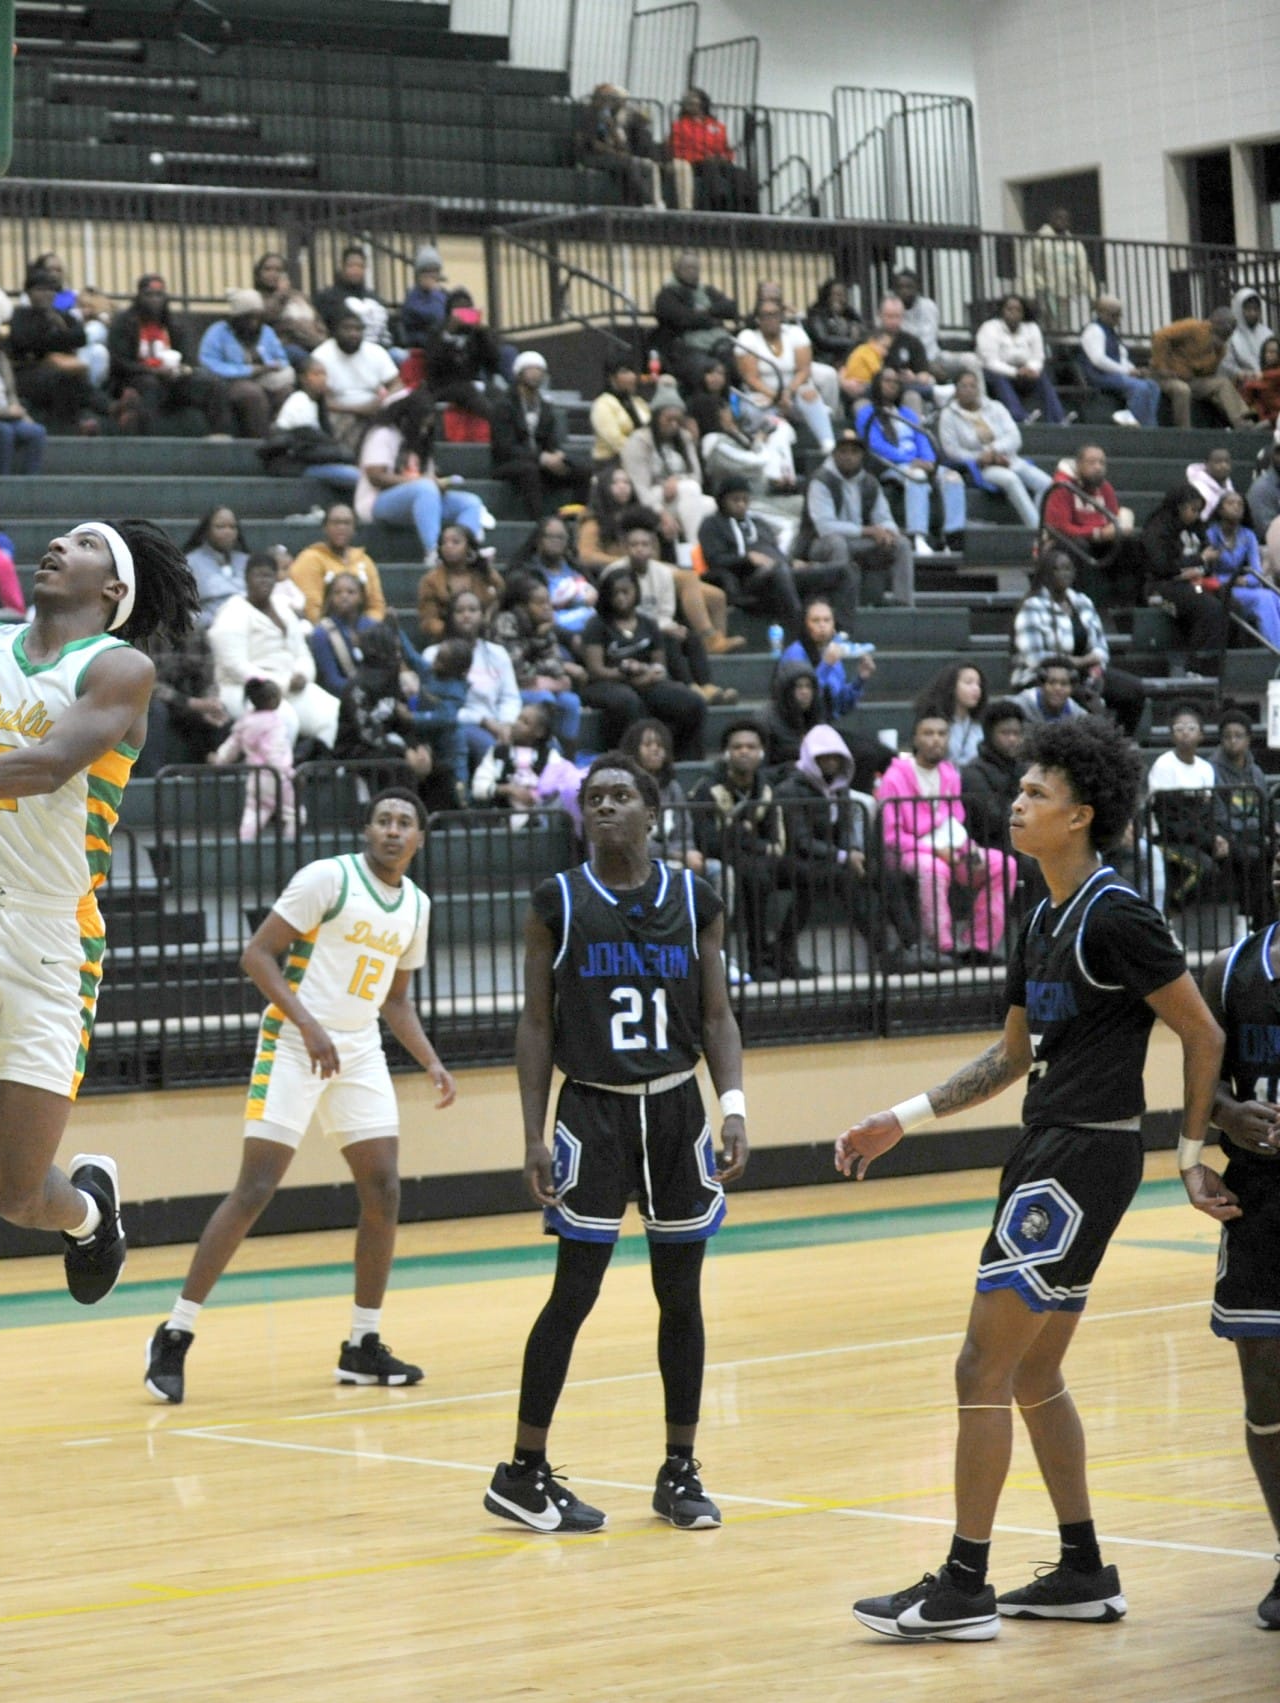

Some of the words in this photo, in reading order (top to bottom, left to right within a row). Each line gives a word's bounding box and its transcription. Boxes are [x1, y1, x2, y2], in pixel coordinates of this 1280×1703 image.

[347, 954, 385, 1001] 12
[579, 942, 689, 979] JOHNSON
[609, 986, 669, 1051] 21
